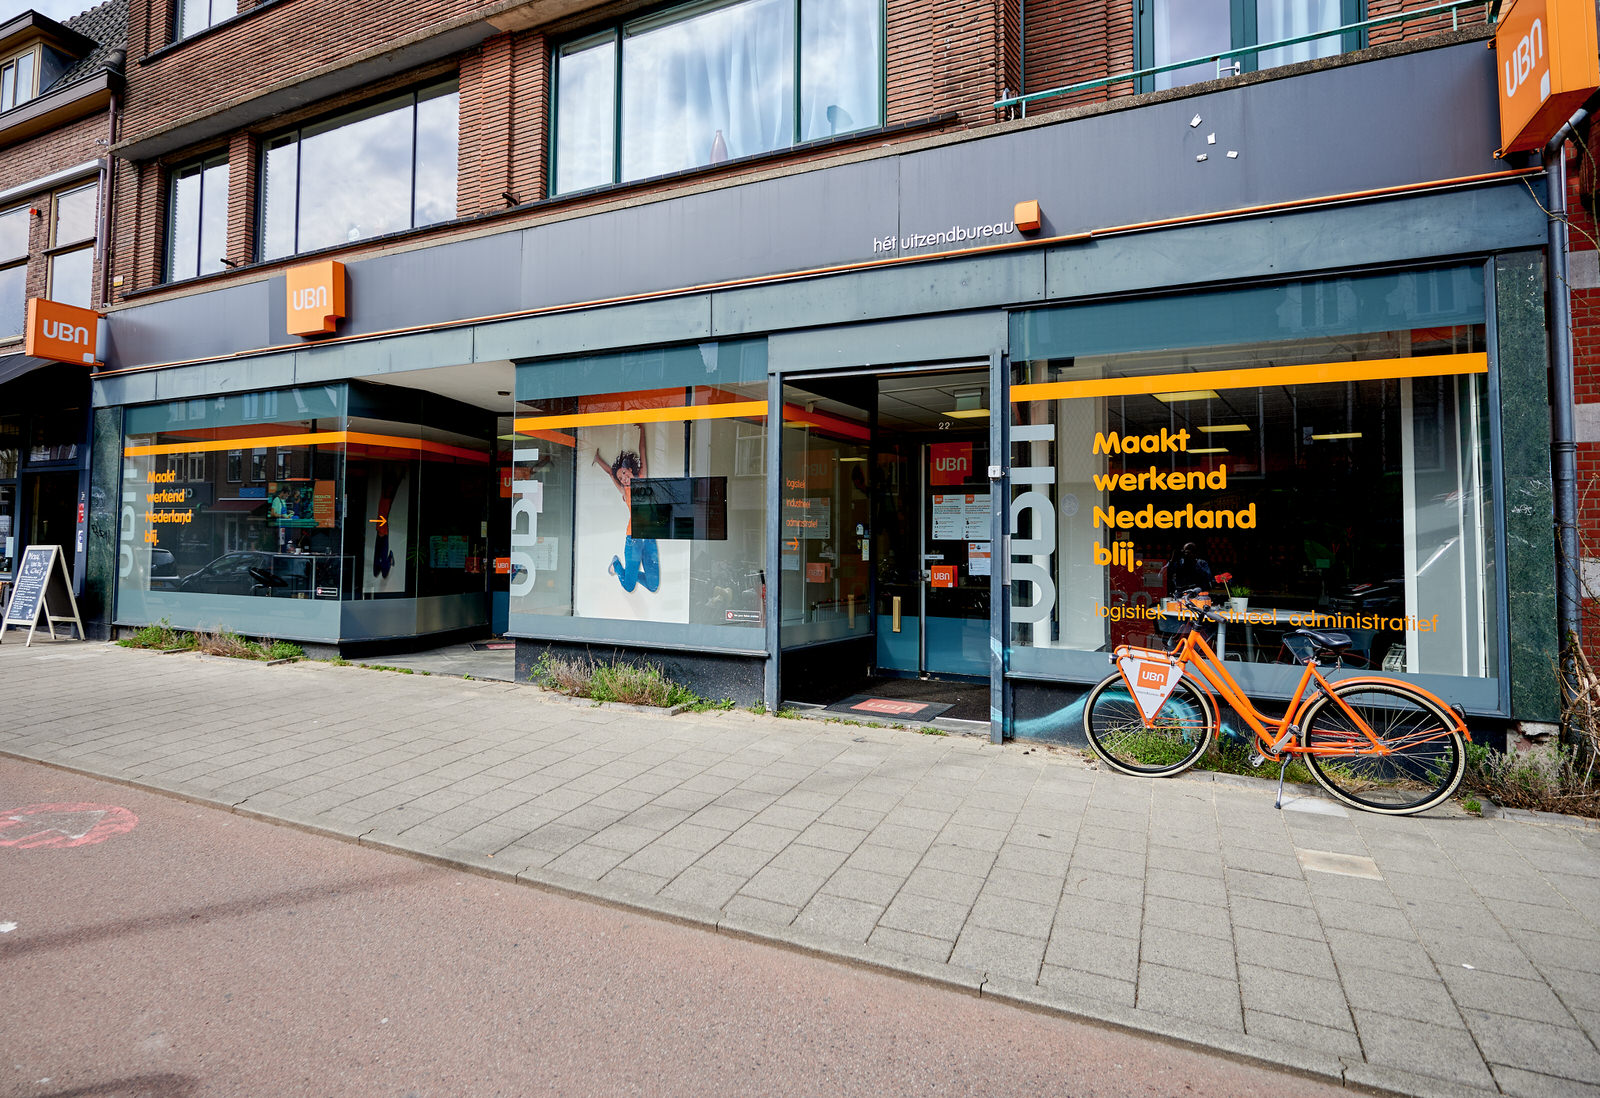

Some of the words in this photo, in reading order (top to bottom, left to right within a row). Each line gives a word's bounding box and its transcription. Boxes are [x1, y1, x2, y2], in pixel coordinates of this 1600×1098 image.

[873, 236, 897, 252] hét
[901, 220, 1014, 249] uitzendbureau
[1093, 427, 1191, 455] Maakt
[146, 469, 176, 483] Maakt
[1093, 464, 1227, 491] werkend
[146, 489, 185, 503] werkend
[145, 509, 192, 525] Nederland
[1093, 502, 1256, 529] Nederland
[144, 529, 159, 546] blij.
[1093, 541, 1142, 573] blij.
[1094, 602, 1167, 621] logistiek
[1176, 602, 1276, 626] instrieel
[1289, 609, 1439, 633] administratief
